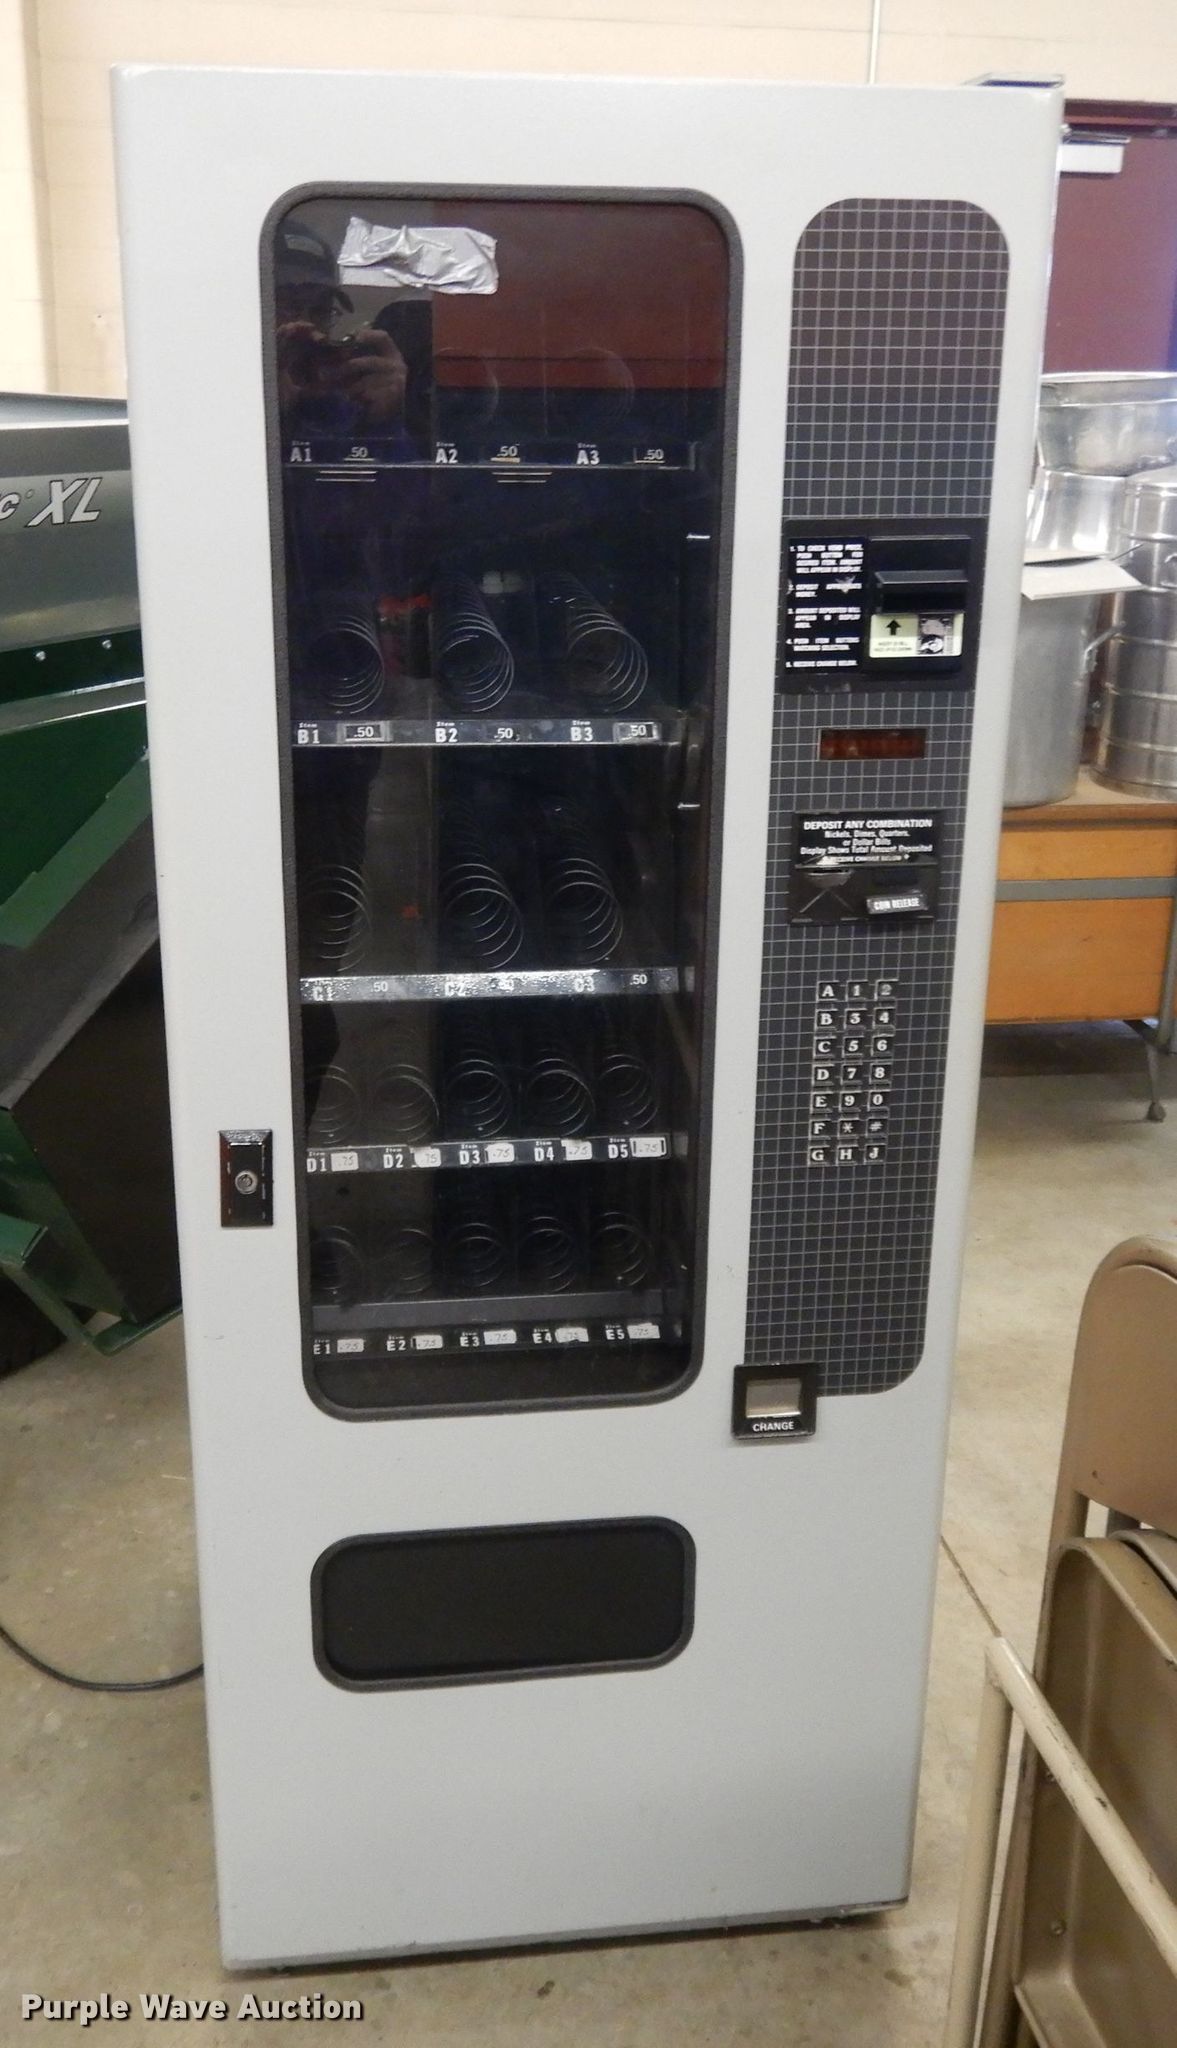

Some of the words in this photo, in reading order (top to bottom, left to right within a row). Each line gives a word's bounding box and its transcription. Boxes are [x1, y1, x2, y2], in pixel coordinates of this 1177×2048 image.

[290, 447, 312, 462] A1
[435, 448, 458, 464] A2
[576, 449, 600, 465] A3
[25, 477, 103, 528] XL
[297, 729, 320, 744] B1
[354, 726, 374, 738] .50
[435, 728, 458, 743] B2
[494, 727, 514, 739] .50
[571, 726, 593, 742] B3
[803, 821, 843, 830] DEPOSIT
[845, 820, 864, 829] ANY
[866, 819, 933, 829] COMBINATION
[370, 981, 389, 993] .50
[574, 976, 594, 992] C3
[630, 974, 648, 985] .50
[822, 985, 835, 998] A
[853, 985, 861, 997] 1
[880, 984, 893, 996] 2
[820, 1013, 833, 1026] B
[850, 1012, 861, 1025] 3
[879, 1011, 890, 1024] 4
[817, 1040, 832, 1053] C
[848, 1040, 859, 1053] 5
[877, 1039, 888, 1052] 6
[816, 1068, 830, 1081] D
[848, 1067, 857, 1080] 7
[874, 1067, 886, 1079] 8
[815, 1095, 827, 1108] E
[844, 1095, 855, 1107] 9
[872, 1094, 883, 1106] 0
[813, 1122, 826, 1135] F
[459, 1150, 480, 1165] D3
[492, 1148, 510, 1158] .75
[534, 1147, 554, 1161] D4
[608, 1143, 629, 1159] D5
[639, 1143, 658, 1153] .75
[811, 1149, 825, 1162] G
[839, 1148, 853, 1161] H
[869, 1147, 880, 1160] J
[306, 1157, 327, 1173] D1
[383, 1153, 404, 1168] D2
[532, 1332, 552, 1344] E4
[605, 1329, 625, 1340] E5
[386, 1340, 407, 1351] E2
[460, 1336, 480, 1347] E3
[313, 1343, 331, 1355] E1
[752, 1421, 795, 1432] CHANGE
